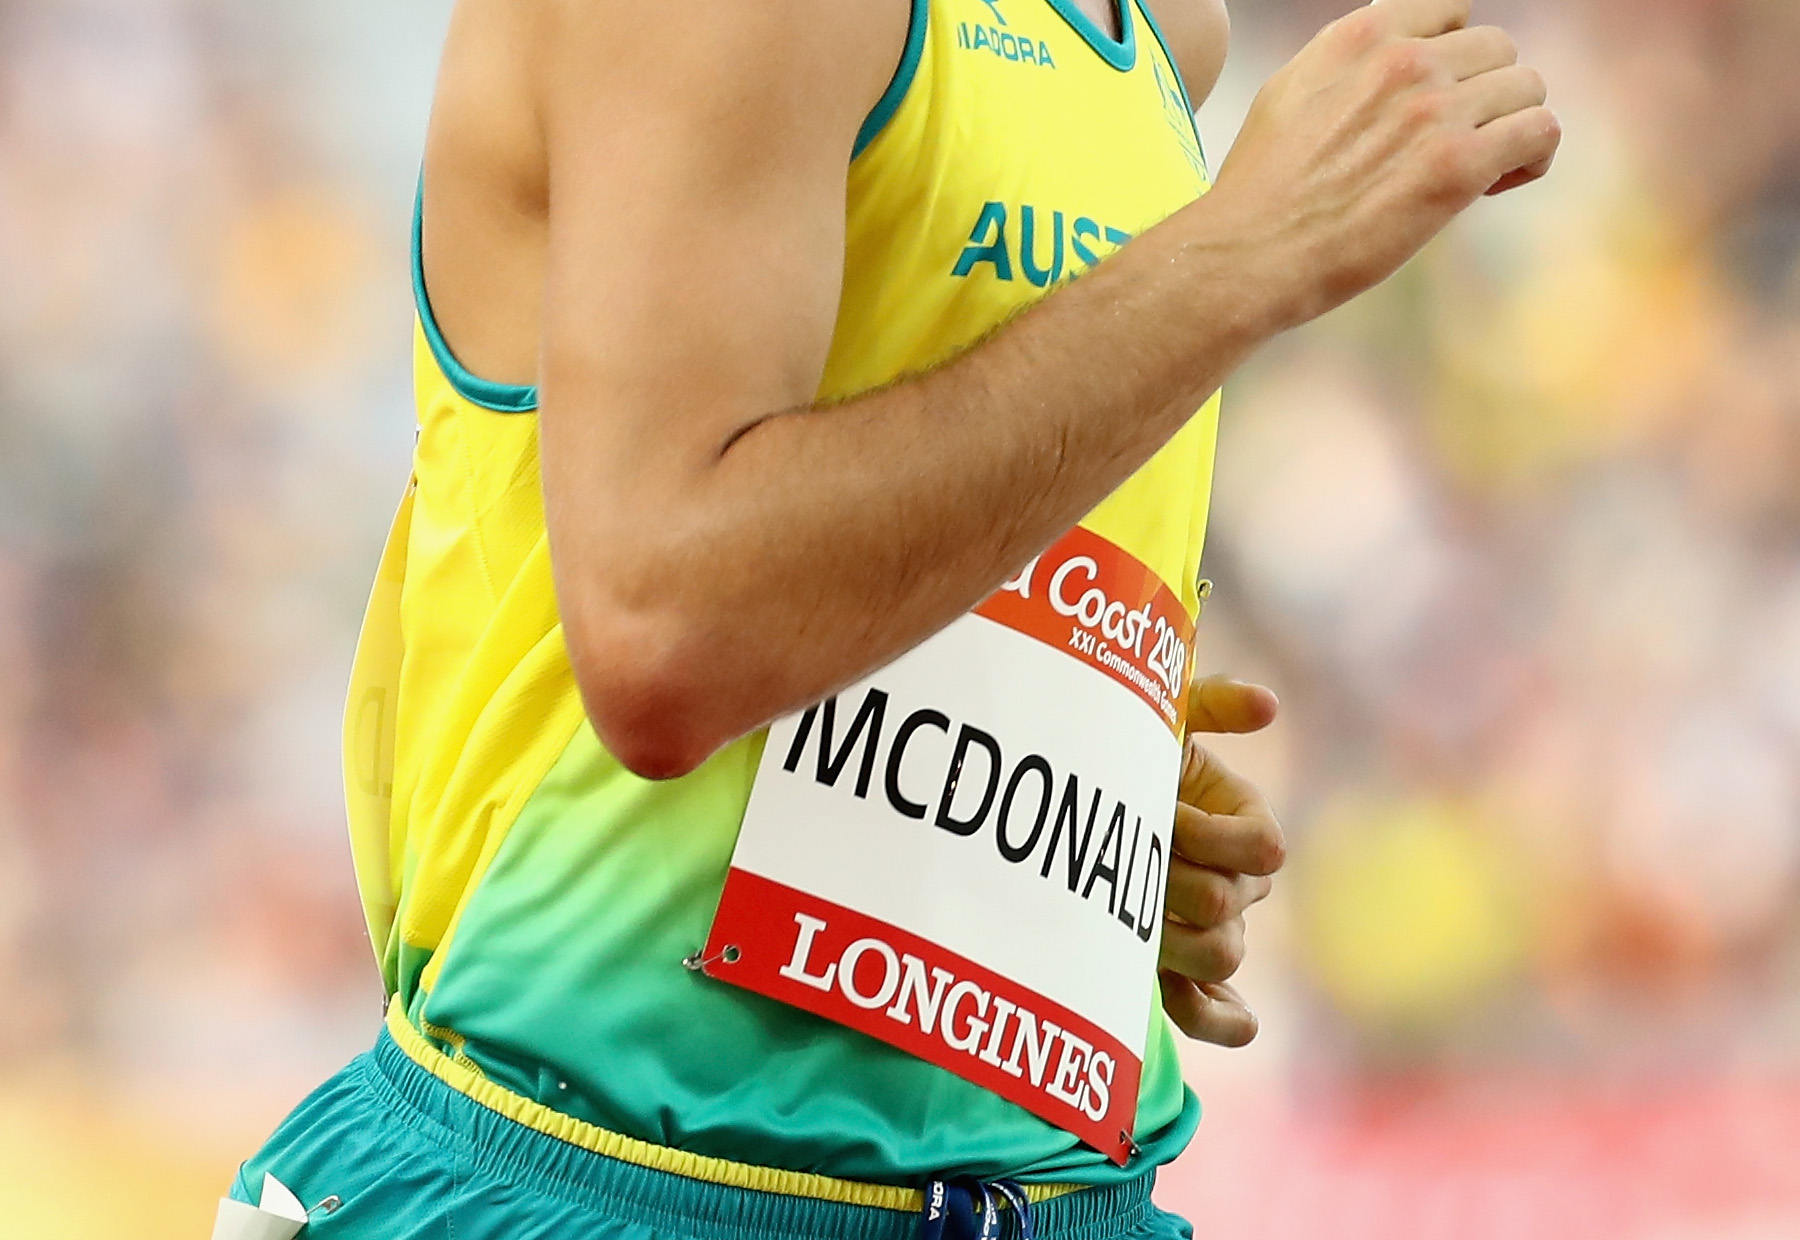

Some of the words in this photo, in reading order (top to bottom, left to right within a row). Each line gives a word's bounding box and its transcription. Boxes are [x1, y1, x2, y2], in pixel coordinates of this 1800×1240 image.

[1048, 555, 1152, 658] Coast
[1147, 616, 1186, 699] 2018
[1068, 626, 1097, 656] XXI
[782, 687, 1164, 943] MCDONALD
[779, 912, 1117, 1123] LONGINES
[928, 1180, 945, 1222] ORA
